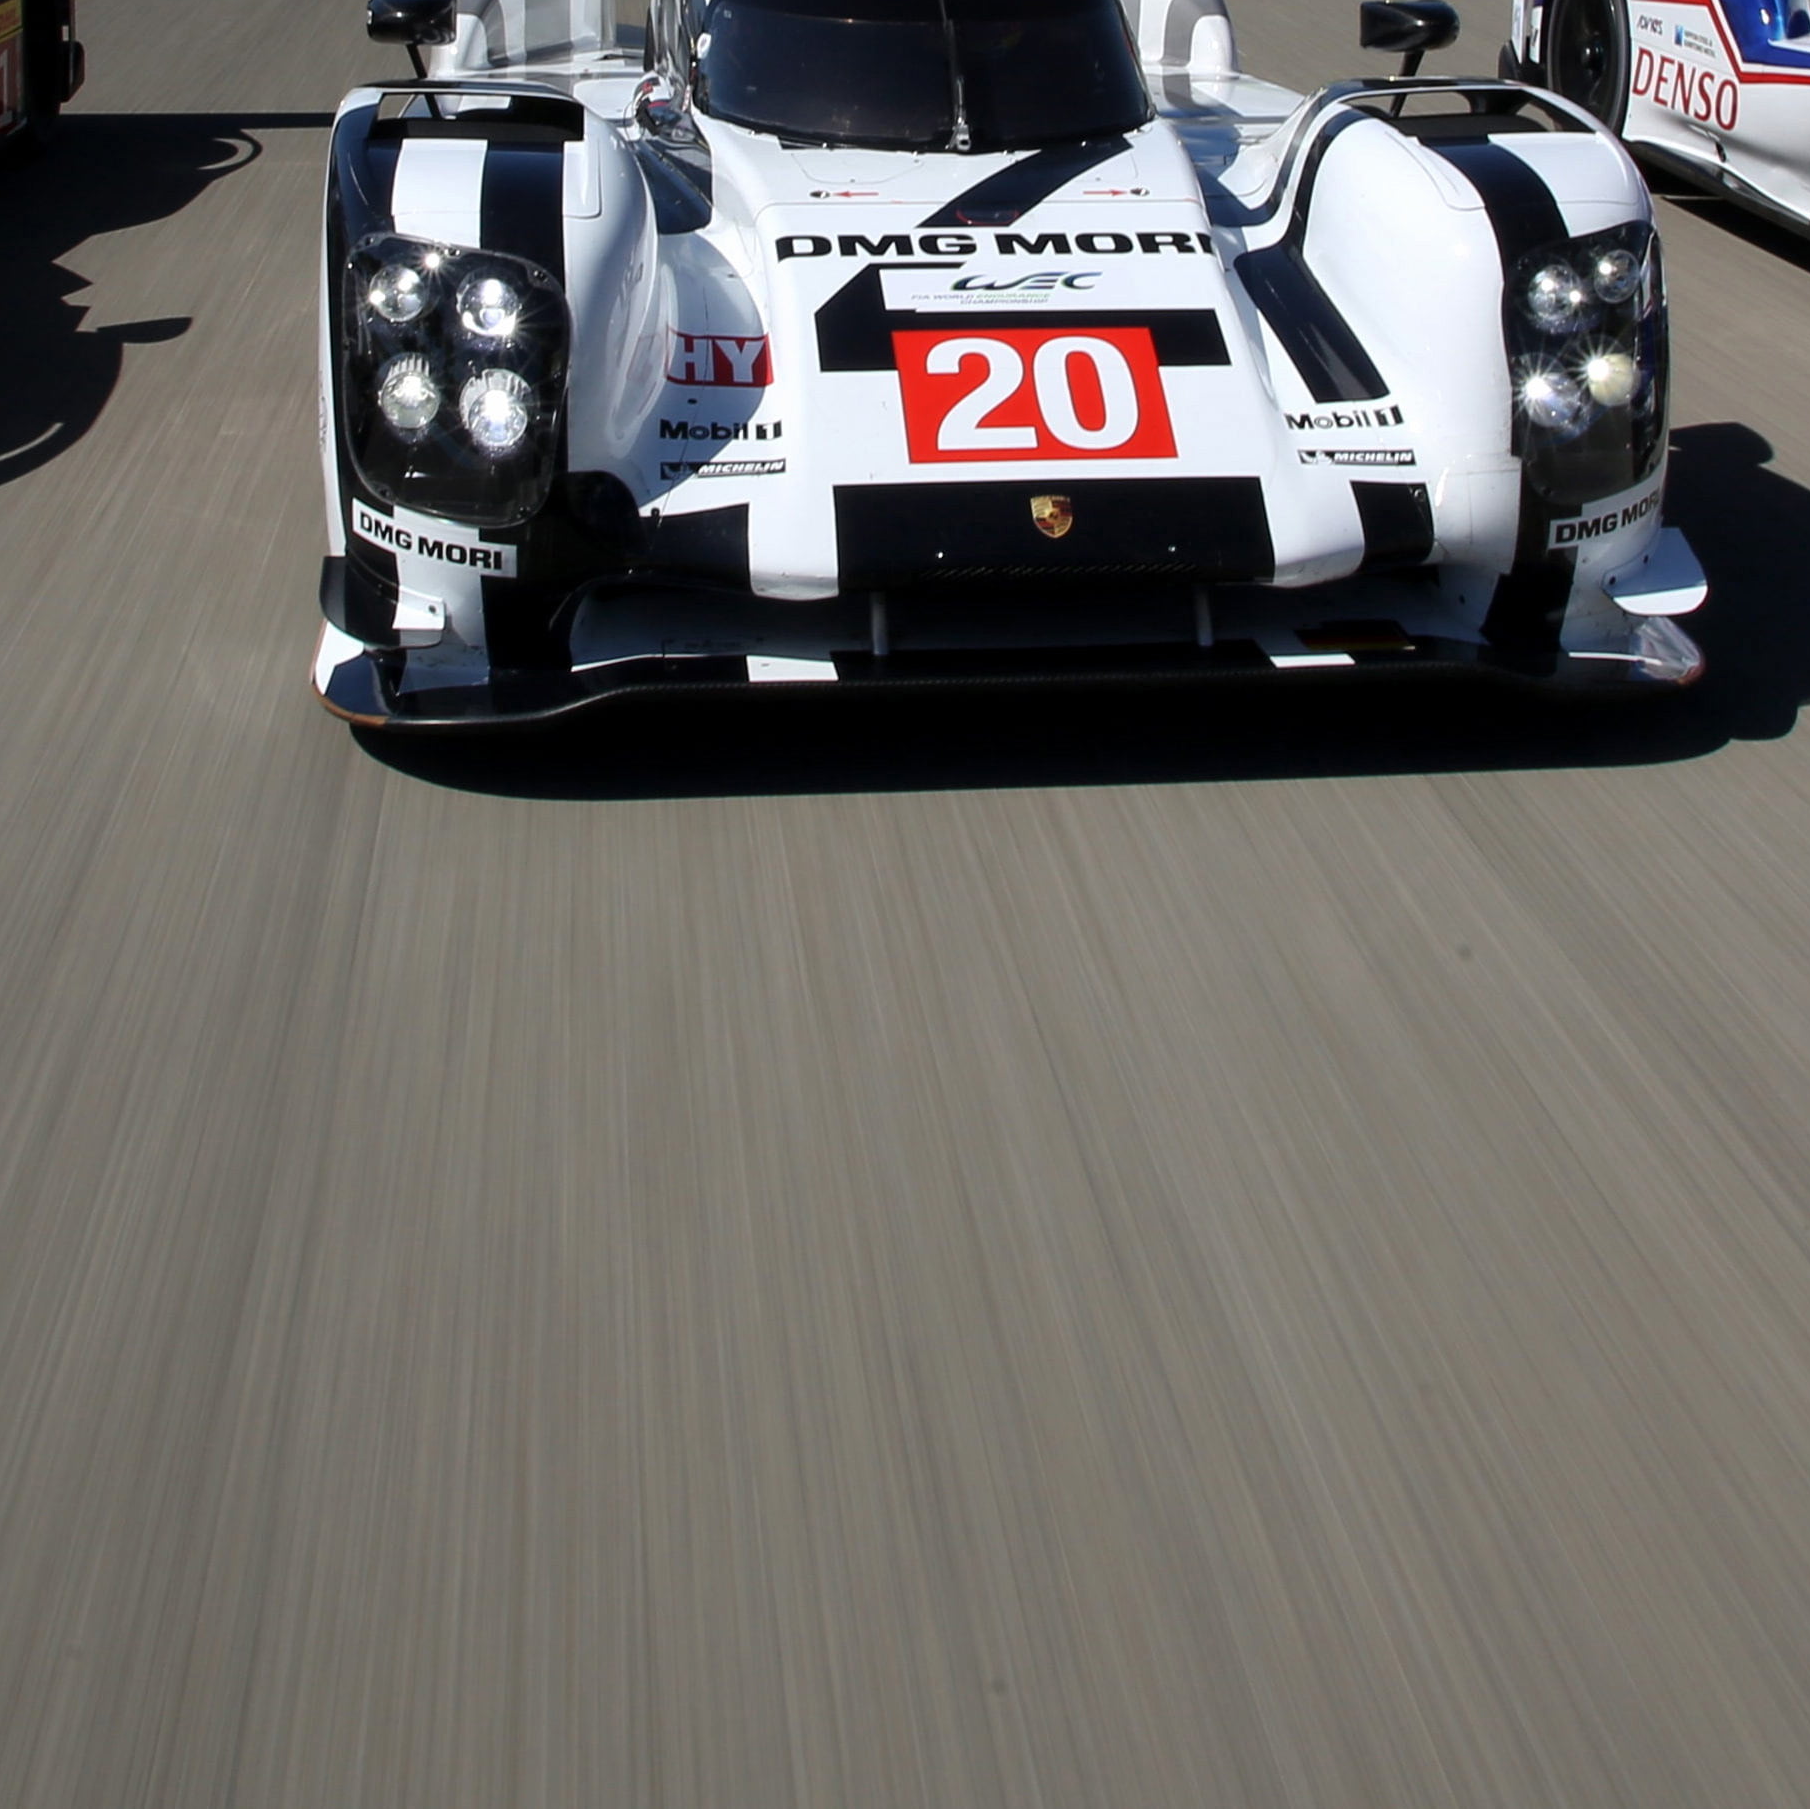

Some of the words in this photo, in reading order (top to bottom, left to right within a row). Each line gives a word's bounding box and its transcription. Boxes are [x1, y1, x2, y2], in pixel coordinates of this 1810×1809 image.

[1631, 46, 1739, 131] DENSO
[775, 233, 977, 263] DMG
[994, 232, 1217, 256] MORI
[670, 339, 766, 383] HY
[925, 335, 1140, 451] 20
[659, 419, 749, 441] Mobil
[1284, 409, 1372, 430] Mobil
[697, 460, 785, 476] MICHELIN
[1332, 451, 1413, 463] MICHELIN
[1555, 512, 1618, 544] DMG
[1621, 486, 1661, 528] MOR
[359, 510, 413, 551] DMG
[417, 534, 503, 571] MORI
